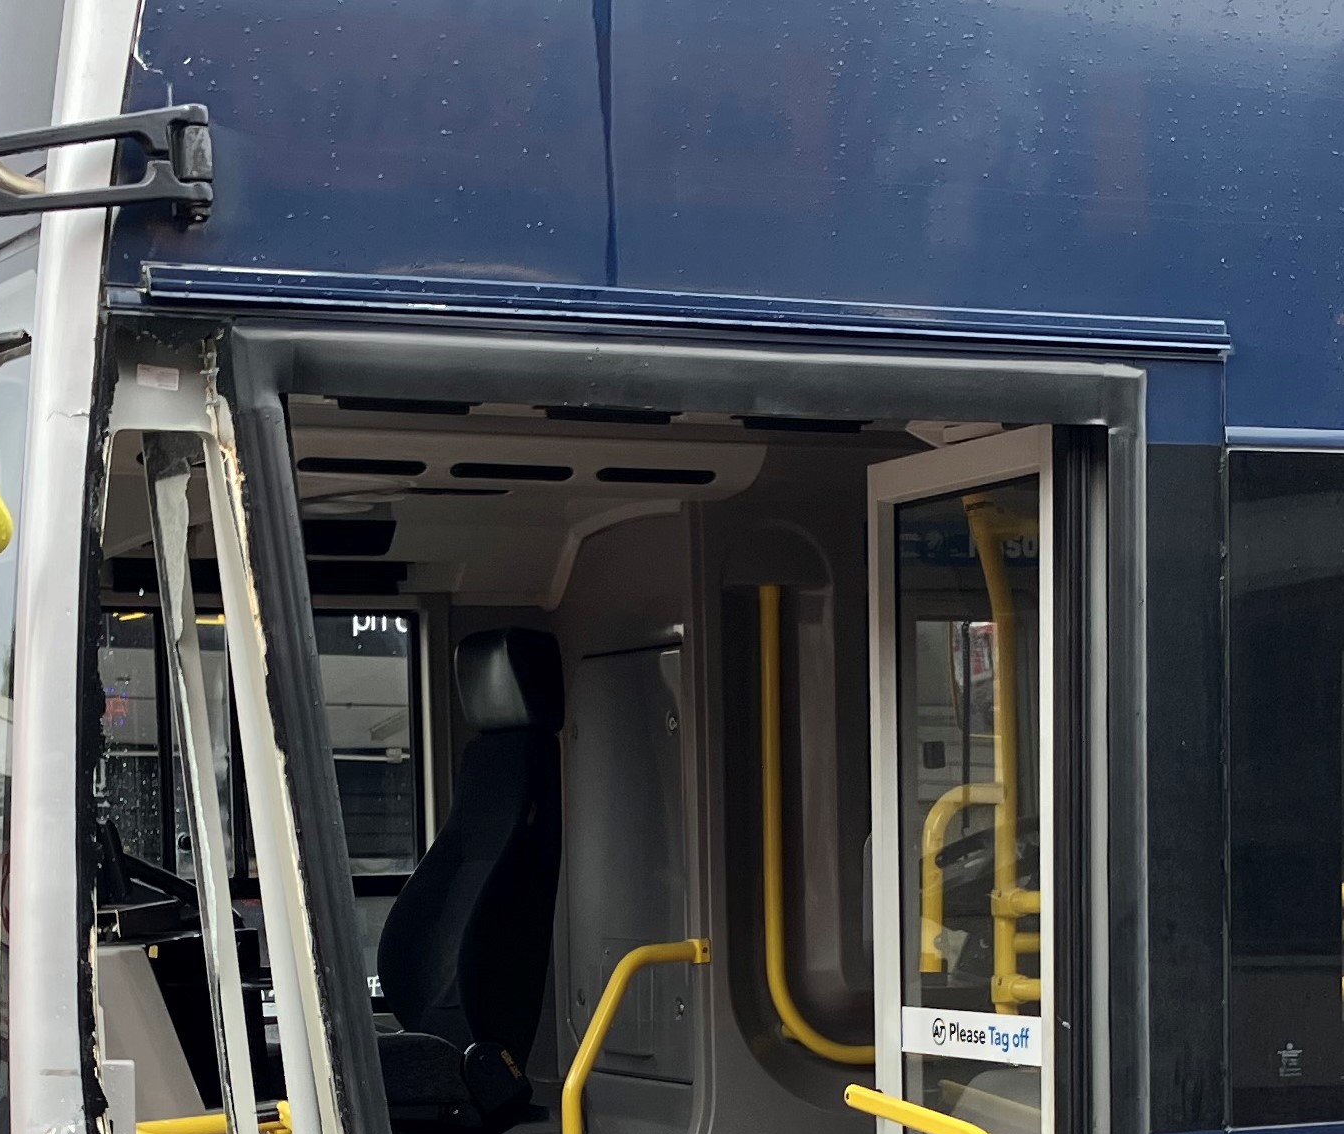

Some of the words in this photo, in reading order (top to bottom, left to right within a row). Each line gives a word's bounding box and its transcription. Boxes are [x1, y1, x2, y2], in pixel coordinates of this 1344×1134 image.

[949, 1022, 985, 1045] Please
[988, 1026, 1009, 1052] Tag
[1012, 1028, 1030, 1049] off
